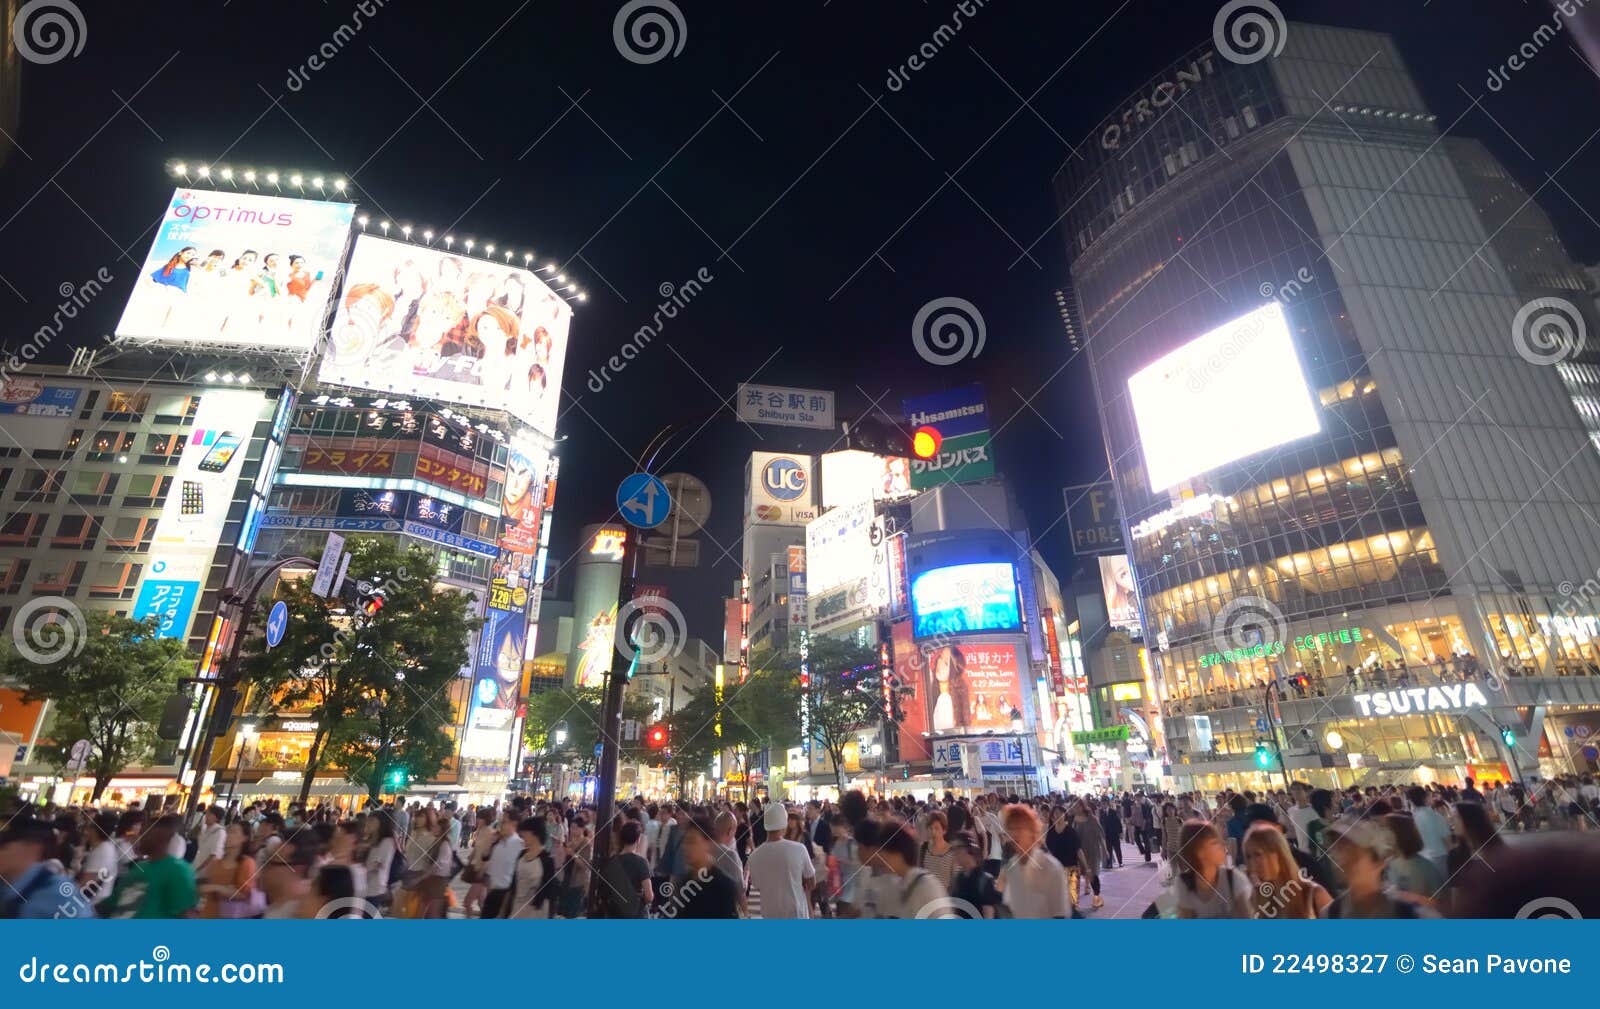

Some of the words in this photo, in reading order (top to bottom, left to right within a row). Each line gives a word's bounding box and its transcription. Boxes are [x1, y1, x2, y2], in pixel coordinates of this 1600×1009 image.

[746, 390, 826, 412] 渋谷駅前
[758, 408, 795, 421] Shibuya
[798, 412, 815, 422] Sta
[911, 403, 984, 426] Hisamitsu
[416, 457, 484, 491] コンタクト
[767, 467, 805, 491] UC
[262, 516, 295, 526] AEON
[795, 511, 814, 519] VISA
[407, 523, 433, 537] AEON
[492, 589, 509, 604] 7.20
[1199, 640, 1286, 668] STARBUCKS
[1294, 627, 1363, 651] COFFEE
[966, 652, 1013, 665] 西野カナ
[1353, 682, 1488, 717] TSUTAYA
[936, 742, 1021, 763] 大盛書店
